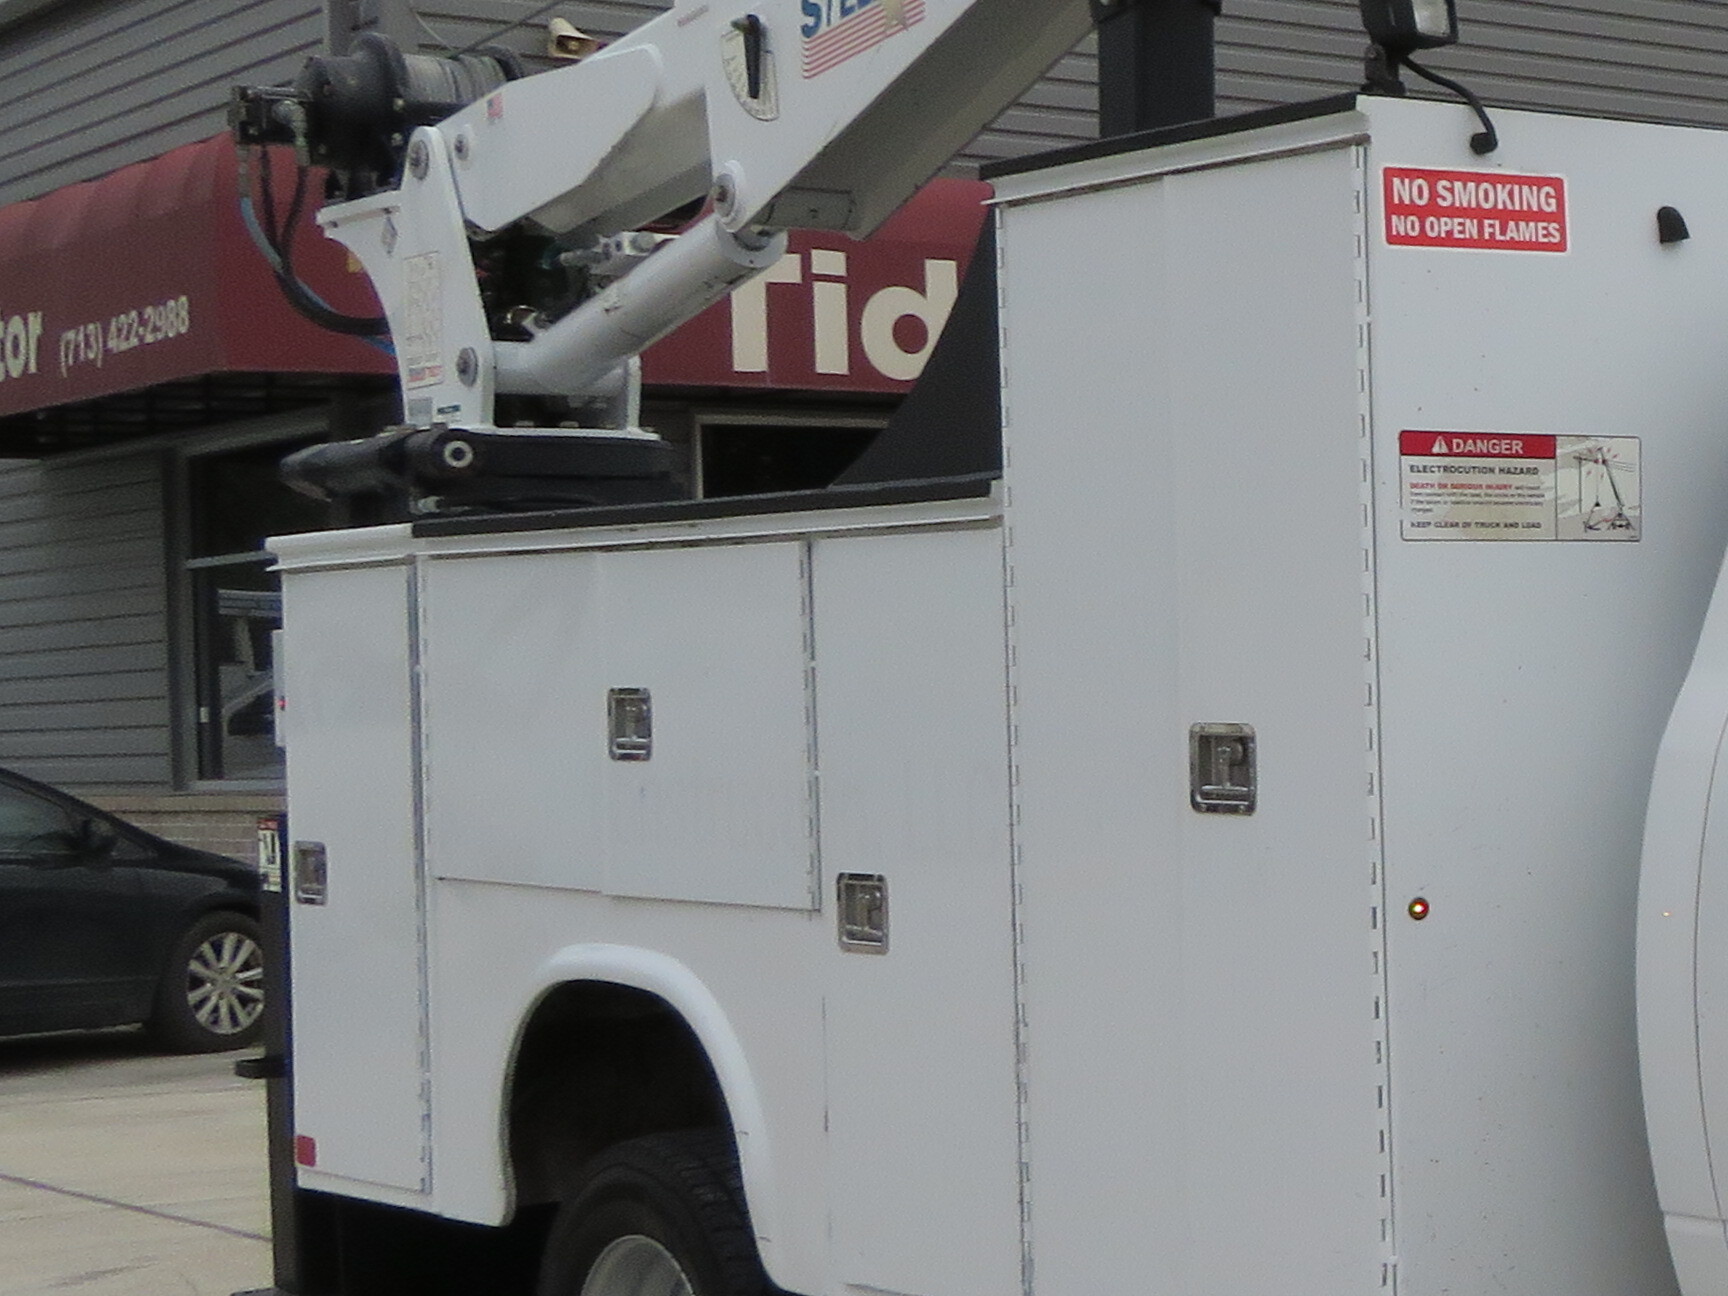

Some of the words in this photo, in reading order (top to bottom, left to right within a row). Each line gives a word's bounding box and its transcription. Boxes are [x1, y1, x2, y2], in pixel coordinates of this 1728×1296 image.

[1391, 177, 1430, 206] NO
[1436, 178, 1557, 212] SMOKING
[1391, 214, 1420, 236] NO
[1425, 216, 1478, 239] OPEN
[1483, 218, 1561, 243] FLAMES
[106, 295, 189, 354] 422-2988
[1452, 438, 1524, 454] DANGER
[1409, 464, 1495, 475] ELECTROCUTION
[1498, 466, 1539, 476] HAZARD
